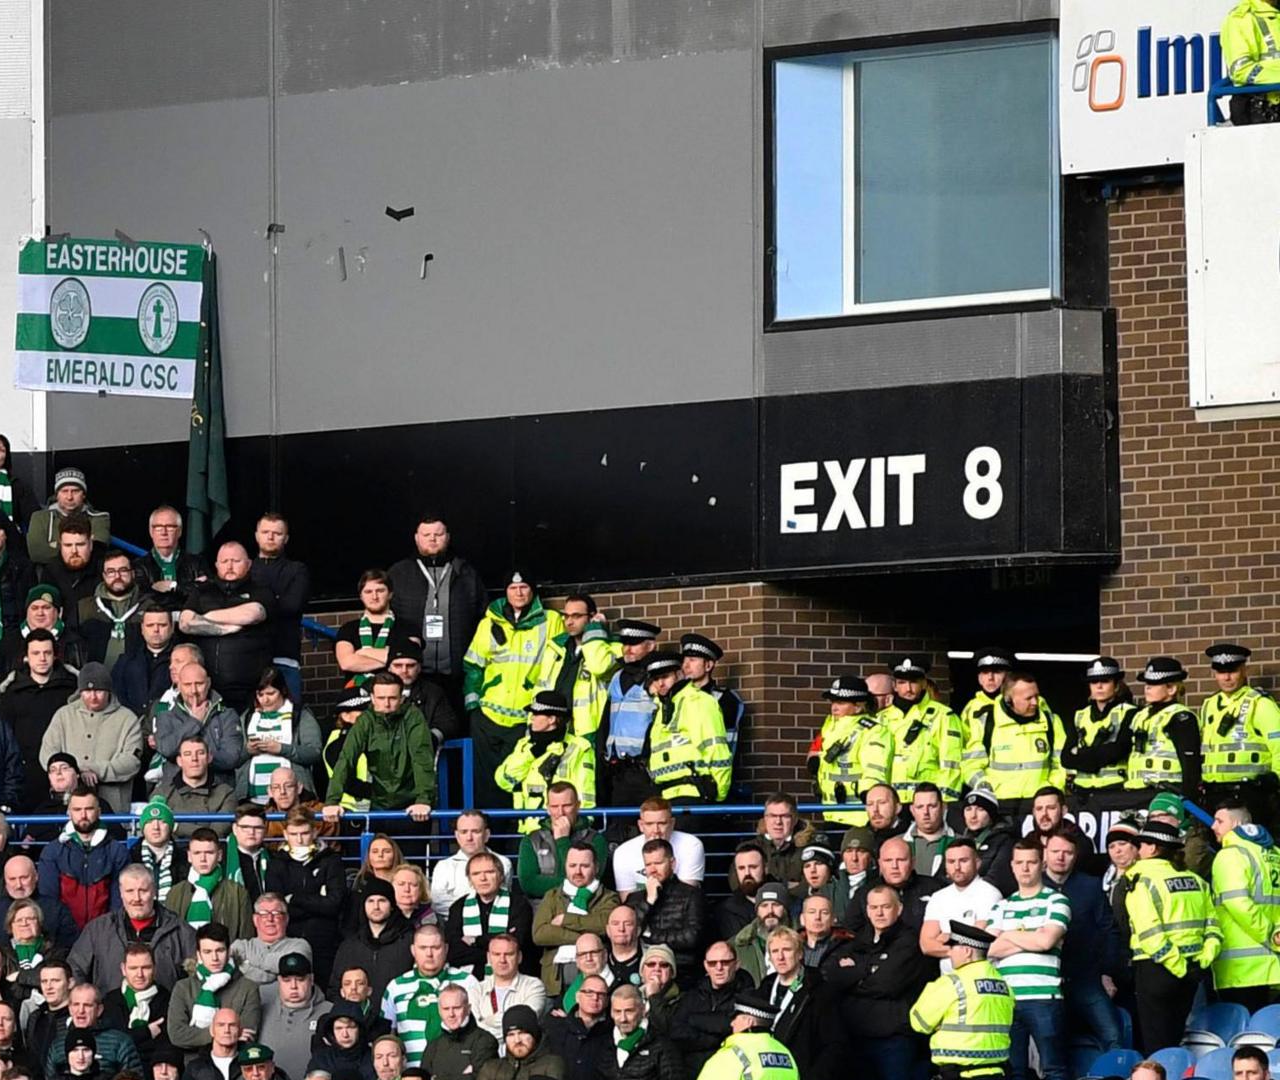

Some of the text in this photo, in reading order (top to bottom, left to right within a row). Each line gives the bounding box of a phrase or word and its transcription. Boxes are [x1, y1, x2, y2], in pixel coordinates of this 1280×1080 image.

[46, 243, 188, 276] EASTERHOUSE
[46, 358, 178, 391] EMERALD CSC
[780, 445, 1004, 534] EXIT 8
